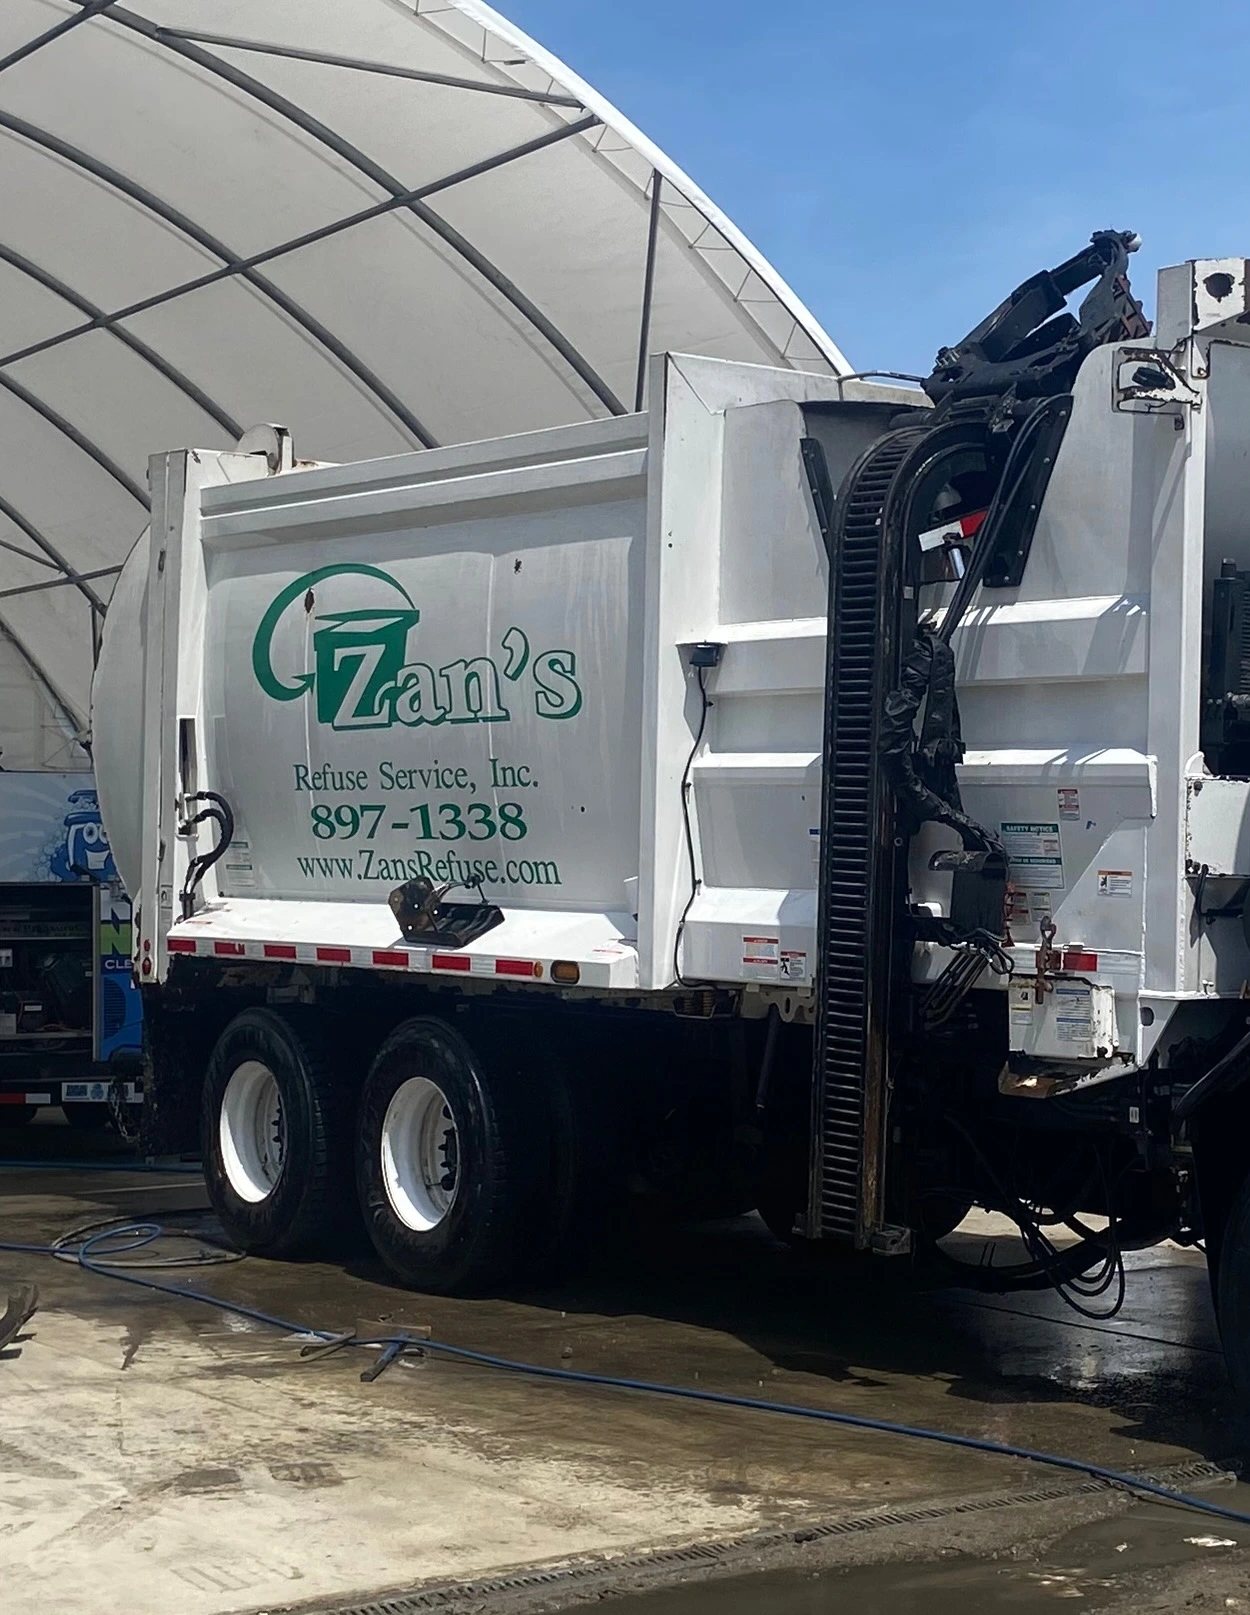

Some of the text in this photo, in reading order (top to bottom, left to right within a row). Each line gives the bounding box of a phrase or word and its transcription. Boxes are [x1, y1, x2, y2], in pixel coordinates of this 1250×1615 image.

[333, 626, 582, 731] Zan's
[293, 758, 539, 793] Refuse Service, Inc.
[311, 803, 528, 840] 897-1338
[297, 850, 562, 885] www.ZansRefuse.com
